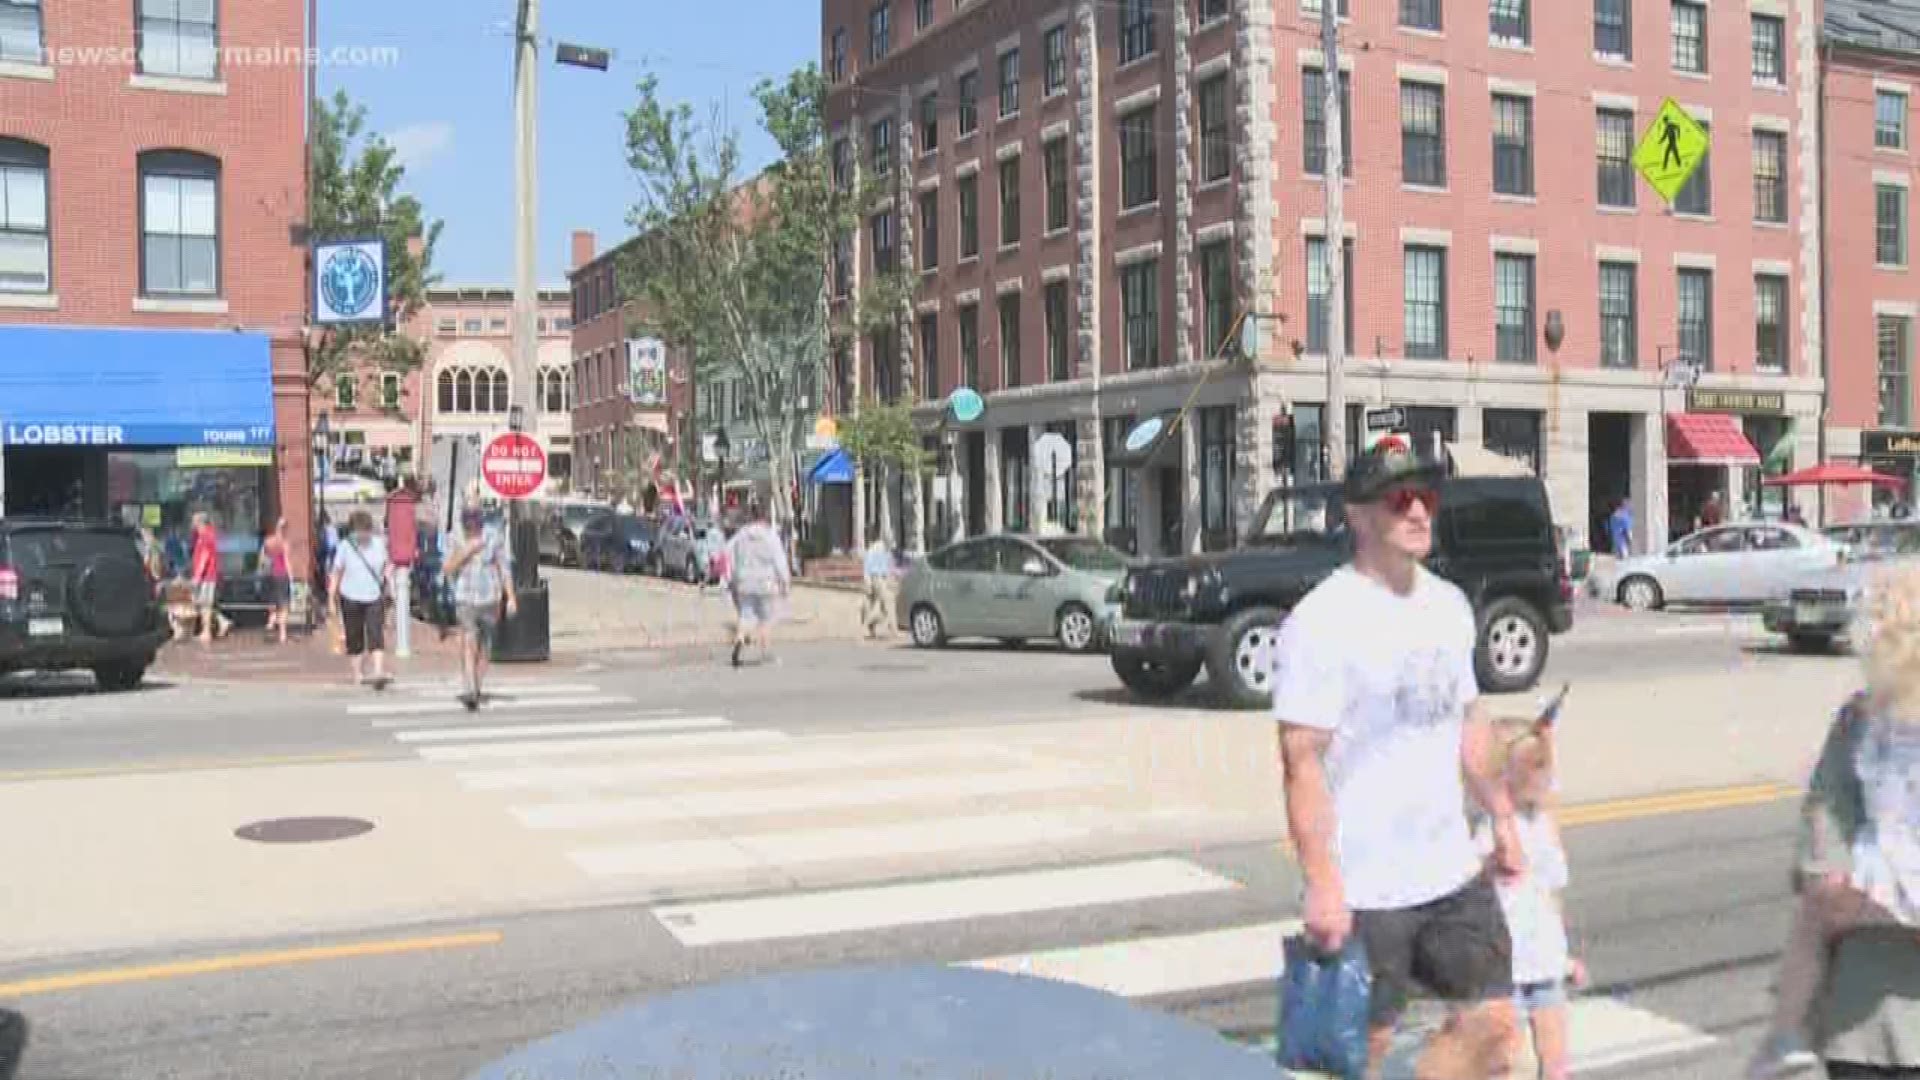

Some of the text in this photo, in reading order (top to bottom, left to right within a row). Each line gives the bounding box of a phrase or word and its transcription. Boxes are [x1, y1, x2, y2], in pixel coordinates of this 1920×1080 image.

[9, 425, 123, 444] LOBSTER
[491, 444, 538, 457] DO NOT
[495, 473, 532, 486] ENTER
